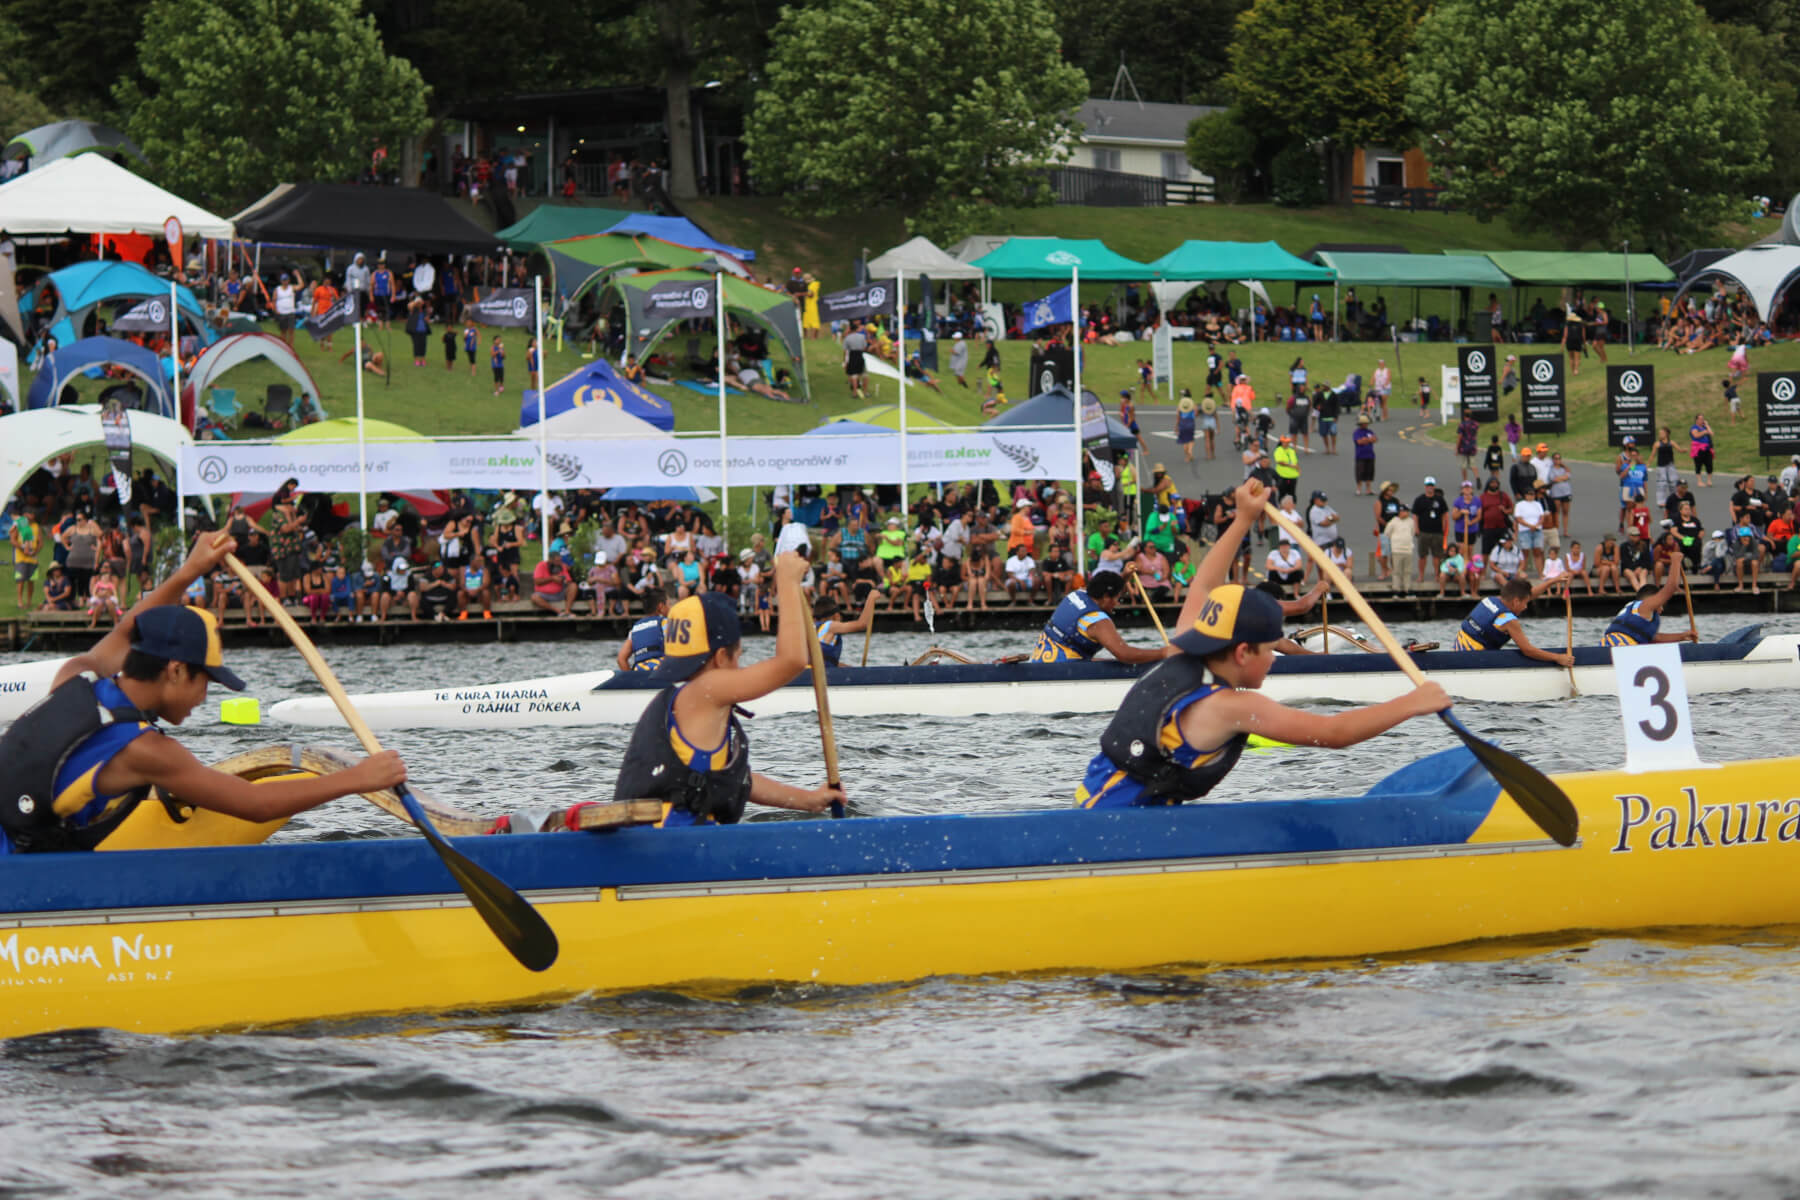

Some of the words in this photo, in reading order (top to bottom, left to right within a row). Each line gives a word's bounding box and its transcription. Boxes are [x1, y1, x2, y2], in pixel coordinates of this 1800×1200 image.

[455, 690, 491, 700] KURA
[495, 688, 548, 700] TUARUA
[462, 703, 472, 714] O
[1633, 665, 1678, 741] 3
[1611, 785, 1800, 853] Pakura
